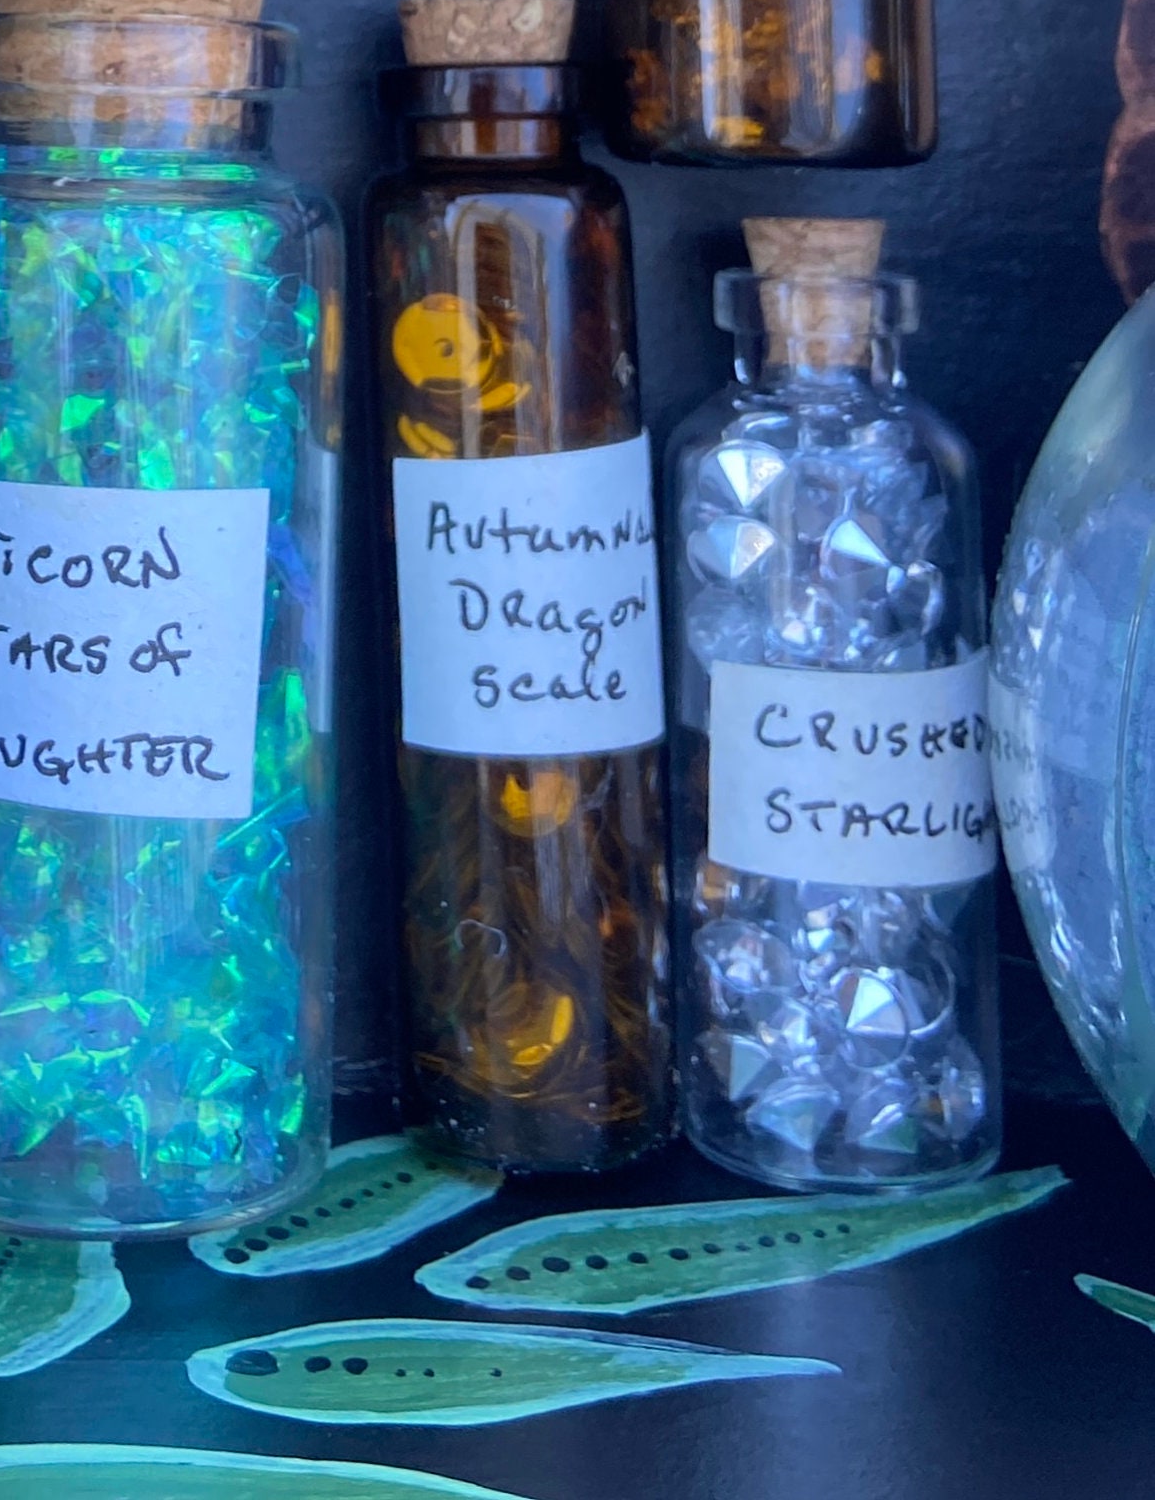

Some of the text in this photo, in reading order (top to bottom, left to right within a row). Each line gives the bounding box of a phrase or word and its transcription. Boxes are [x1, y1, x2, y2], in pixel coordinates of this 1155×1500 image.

[128, 621, 192, 676] of
[471, 655, 627, 709] Scale
[755, 703, 990, 759] CRUSHED
